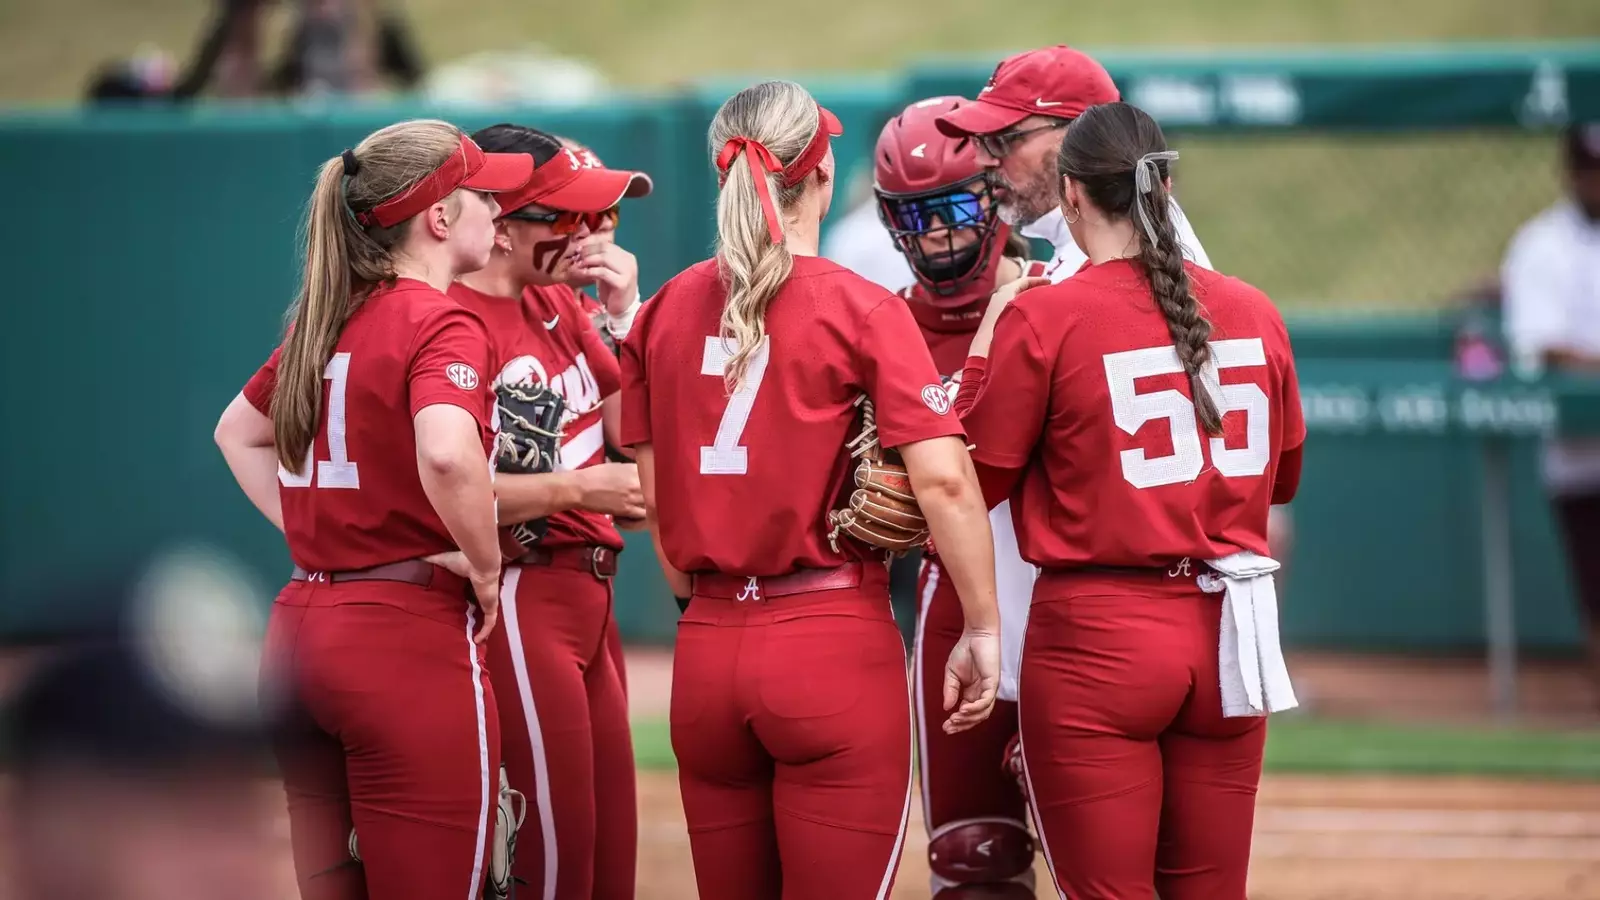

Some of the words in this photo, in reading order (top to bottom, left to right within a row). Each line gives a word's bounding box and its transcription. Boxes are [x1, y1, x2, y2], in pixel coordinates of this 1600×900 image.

[449, 364, 477, 388] SEC
[700, 335, 770, 474] 7
[923, 386, 949, 413] SEC
[278, 352, 360, 489] 1
[1102, 338, 1270, 489] 55
[1168, 557, 1192, 577] A
[737, 575, 760, 601] A
